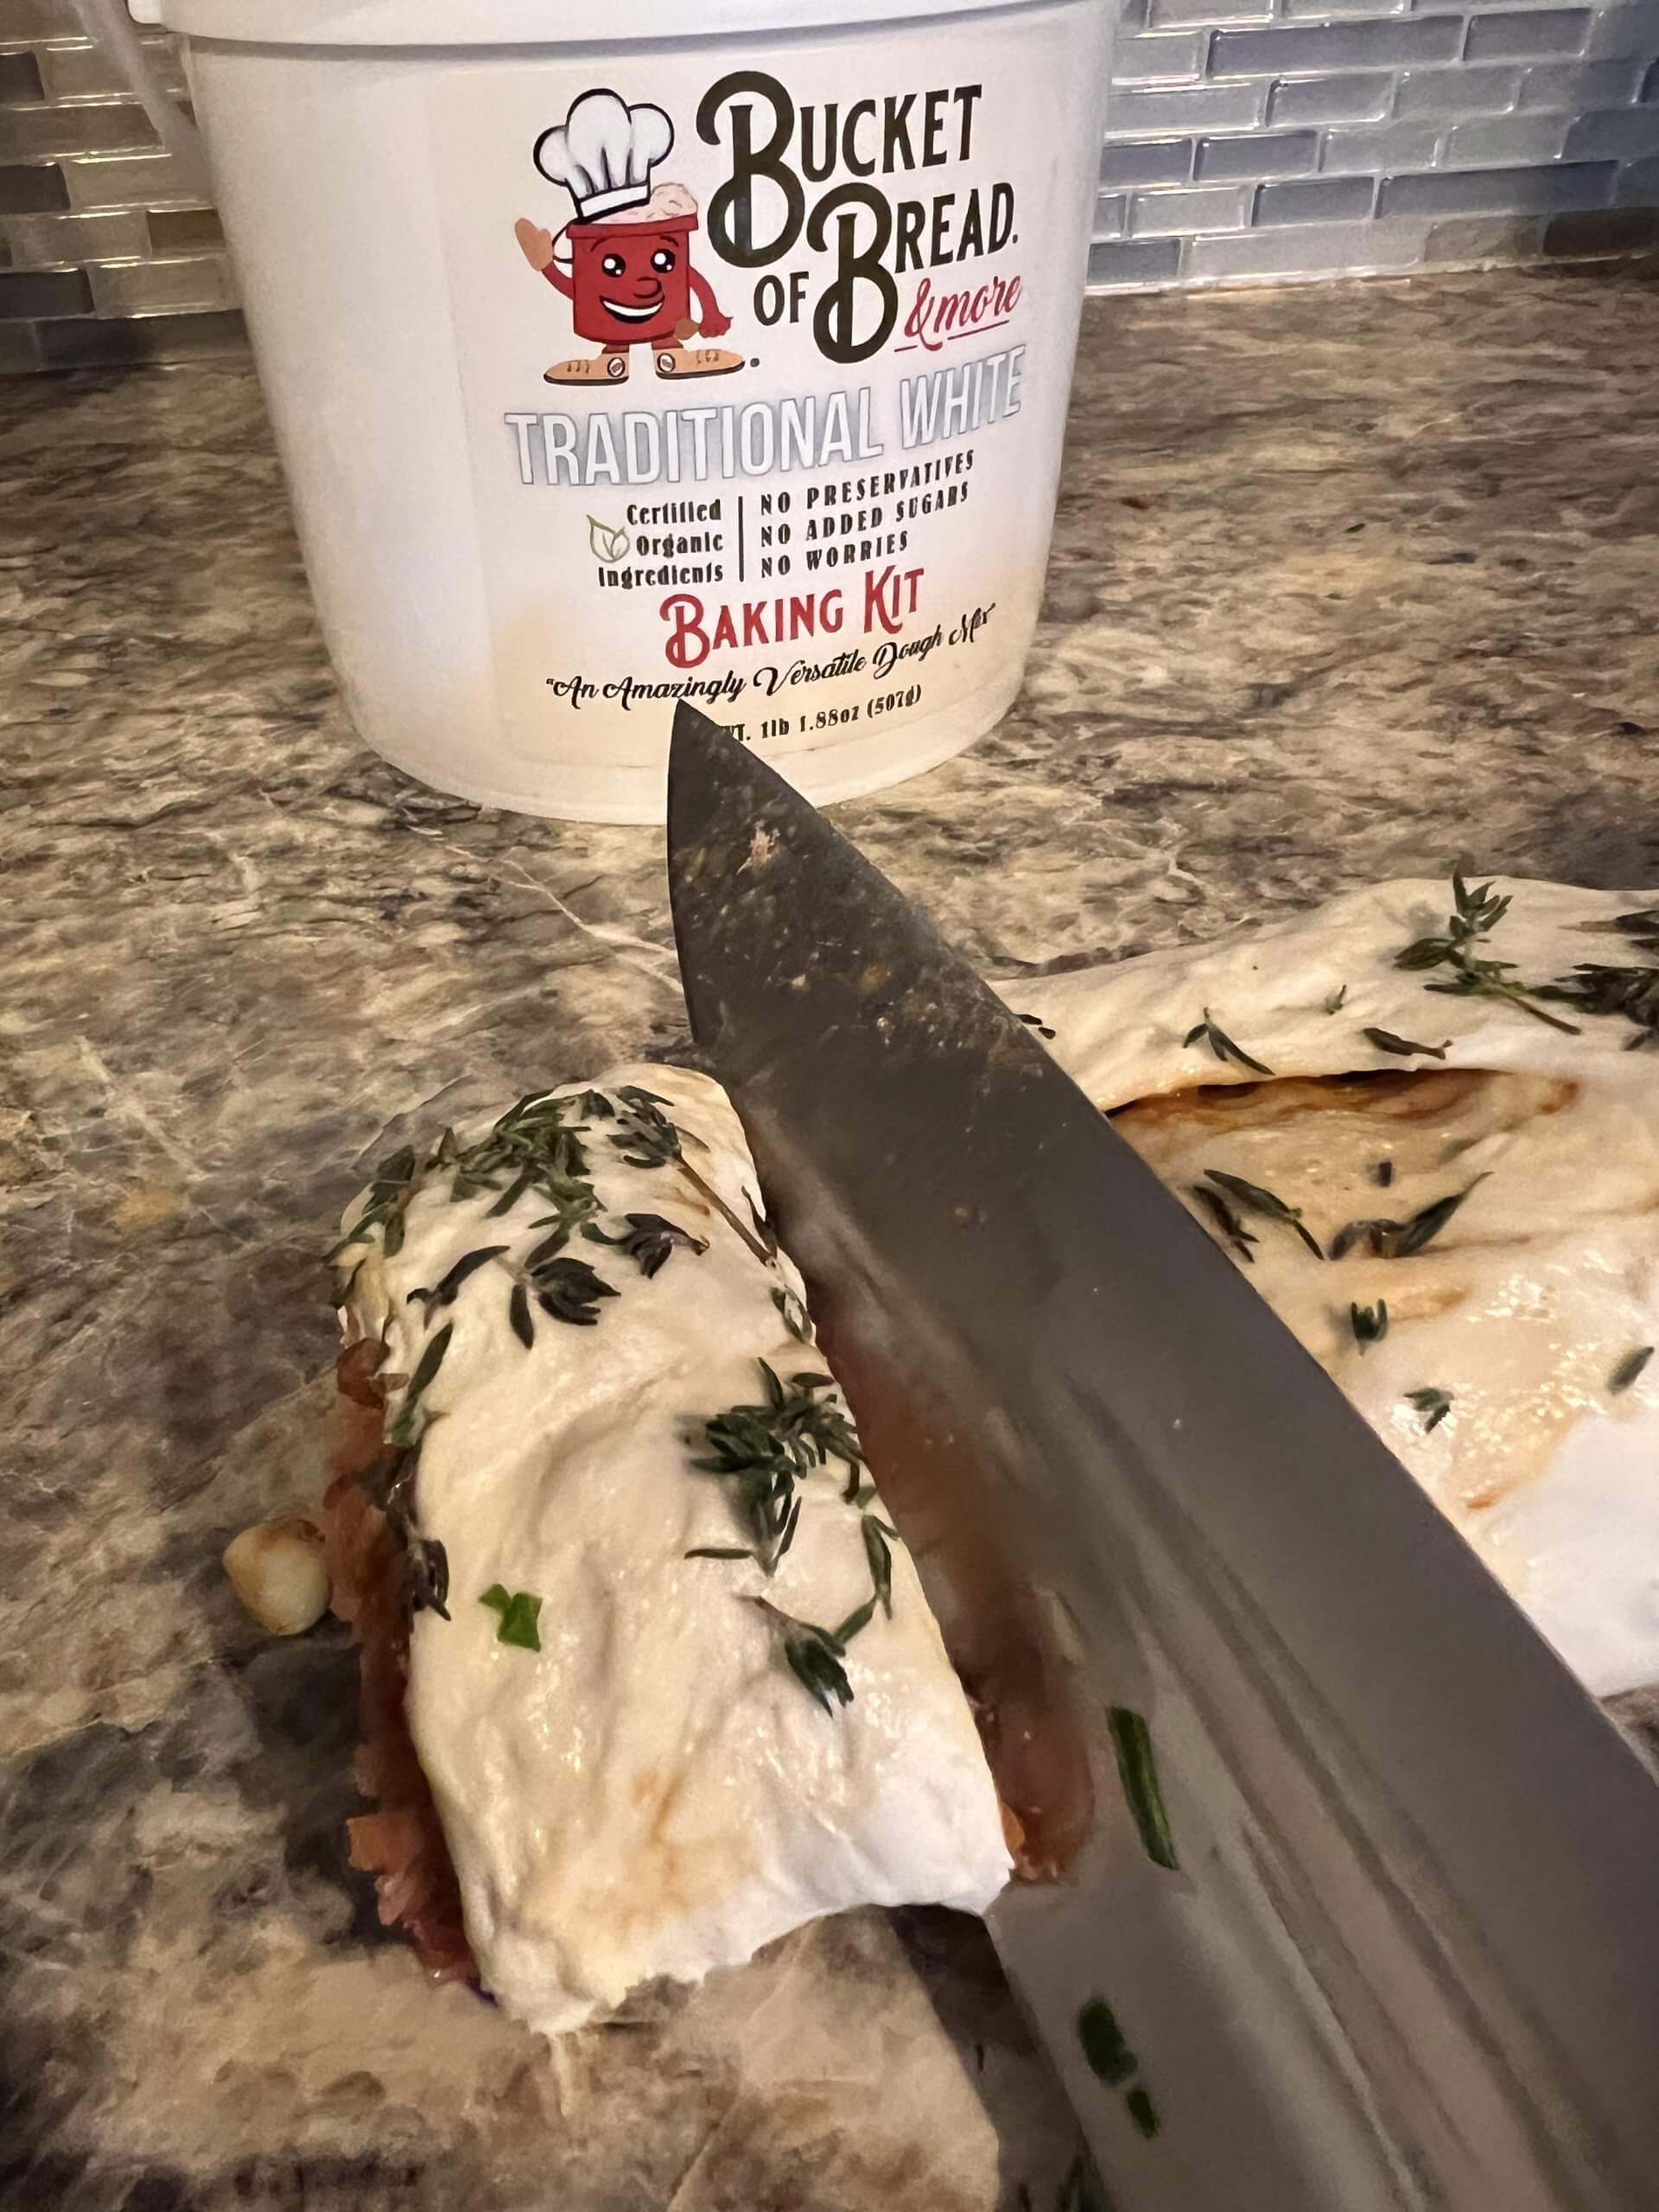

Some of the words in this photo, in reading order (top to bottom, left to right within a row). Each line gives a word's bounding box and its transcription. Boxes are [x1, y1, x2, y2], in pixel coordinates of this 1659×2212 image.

[696, 70, 982, 269] BUCKET
[753, 271, 809, 327] OF
[904, 275, 1023, 352] &more
[504, 387, 884, 486] TRADITIONAL
[900, 344, 1027, 450] WHITE
[626, 499, 721, 525] Certified
[760, 491, 791, 516] NO
[806, 448, 974, 510] PRESERVATIVES
[760, 523, 791, 548] NO
[805, 506, 883, 541] ADDED
[895, 480, 969, 522] SUGARS
[598, 563, 724, 590] Ingredients
[636, 531, 723, 559] Organic
[760, 555, 791, 578] NO
[805, 530, 908, 571] WORRIES
[659, 589, 843, 669] BAKING
[863, 564, 925, 635] KIT
[602, 670, 747, 711] Amazingly
[753, 648, 868, 697] Versatile
[872, 624, 944, 680] Dough
[800, 705, 860, 733] 1.88oz
[867, 683, 922, 719] (507g)
